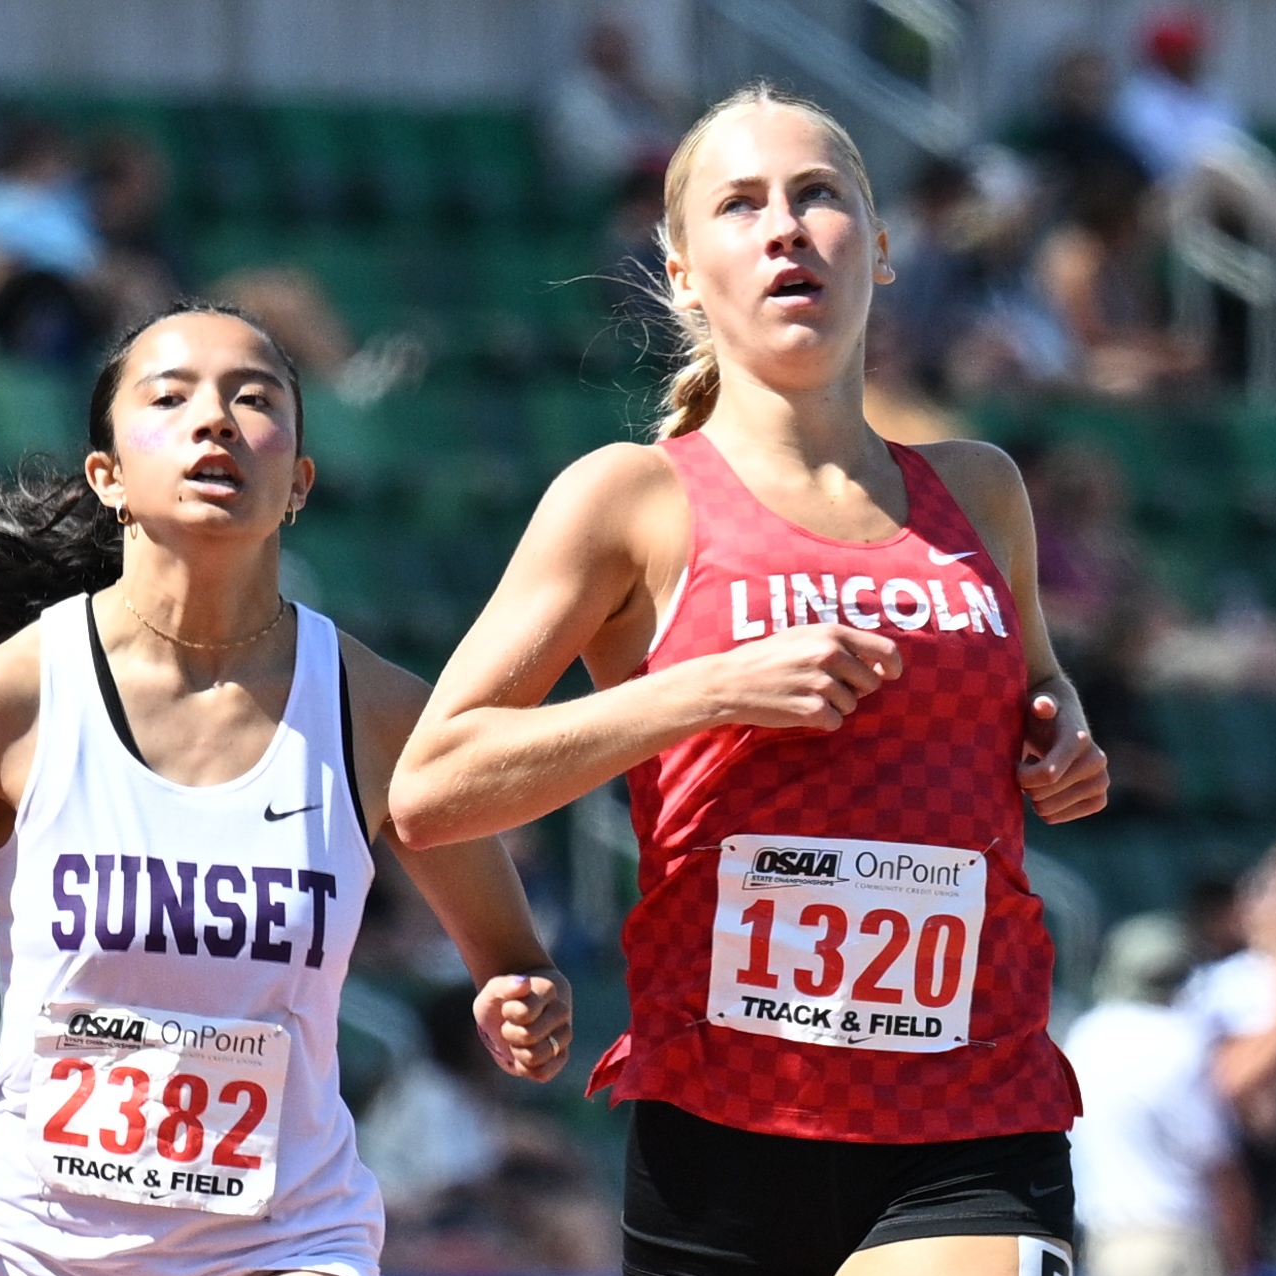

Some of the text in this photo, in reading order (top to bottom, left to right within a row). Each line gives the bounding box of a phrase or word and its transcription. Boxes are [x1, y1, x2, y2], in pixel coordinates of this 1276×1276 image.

[730, 573, 1009, 641] LINCOLN
[756, 851, 838, 877] OSAA
[855, 851, 960, 886] OnPoint
[51, 853, 337, 970] SUNSET
[736, 899, 967, 1008] 1320
[68, 1013, 144, 1042] OSAA
[161, 1020, 266, 1057] OnPoint
[741, 996, 832, 1029] TRACK
[840, 1010, 861, 1033] &
[869, 1013, 943, 1039] FIELD
[42, 1057, 269, 1171] 2382
[53, 1155, 244, 1197] TRACK & FIELD
